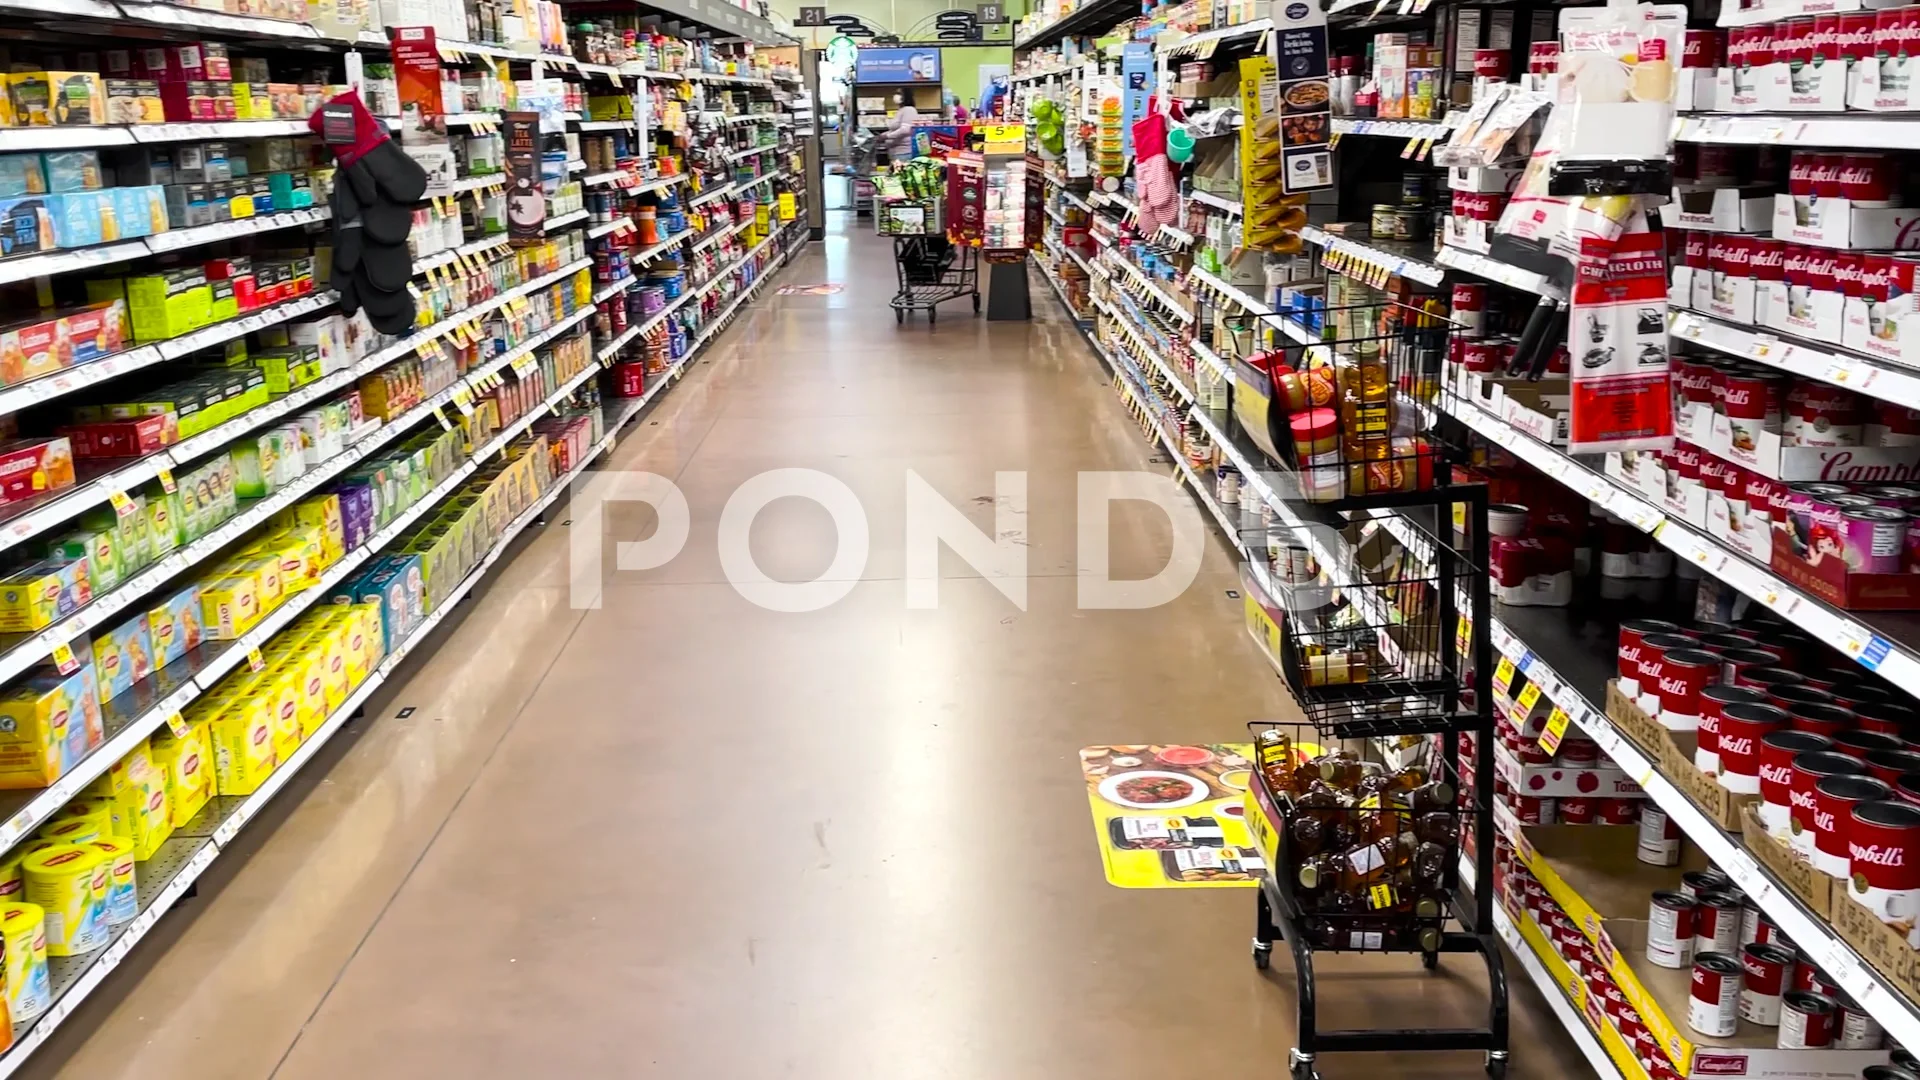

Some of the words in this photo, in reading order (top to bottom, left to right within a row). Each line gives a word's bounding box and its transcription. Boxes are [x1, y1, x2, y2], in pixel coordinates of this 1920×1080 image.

[805, 9, 821, 23] 21
[983, 6, 997, 20] 19
[220, 602, 230, 625] LOVE
